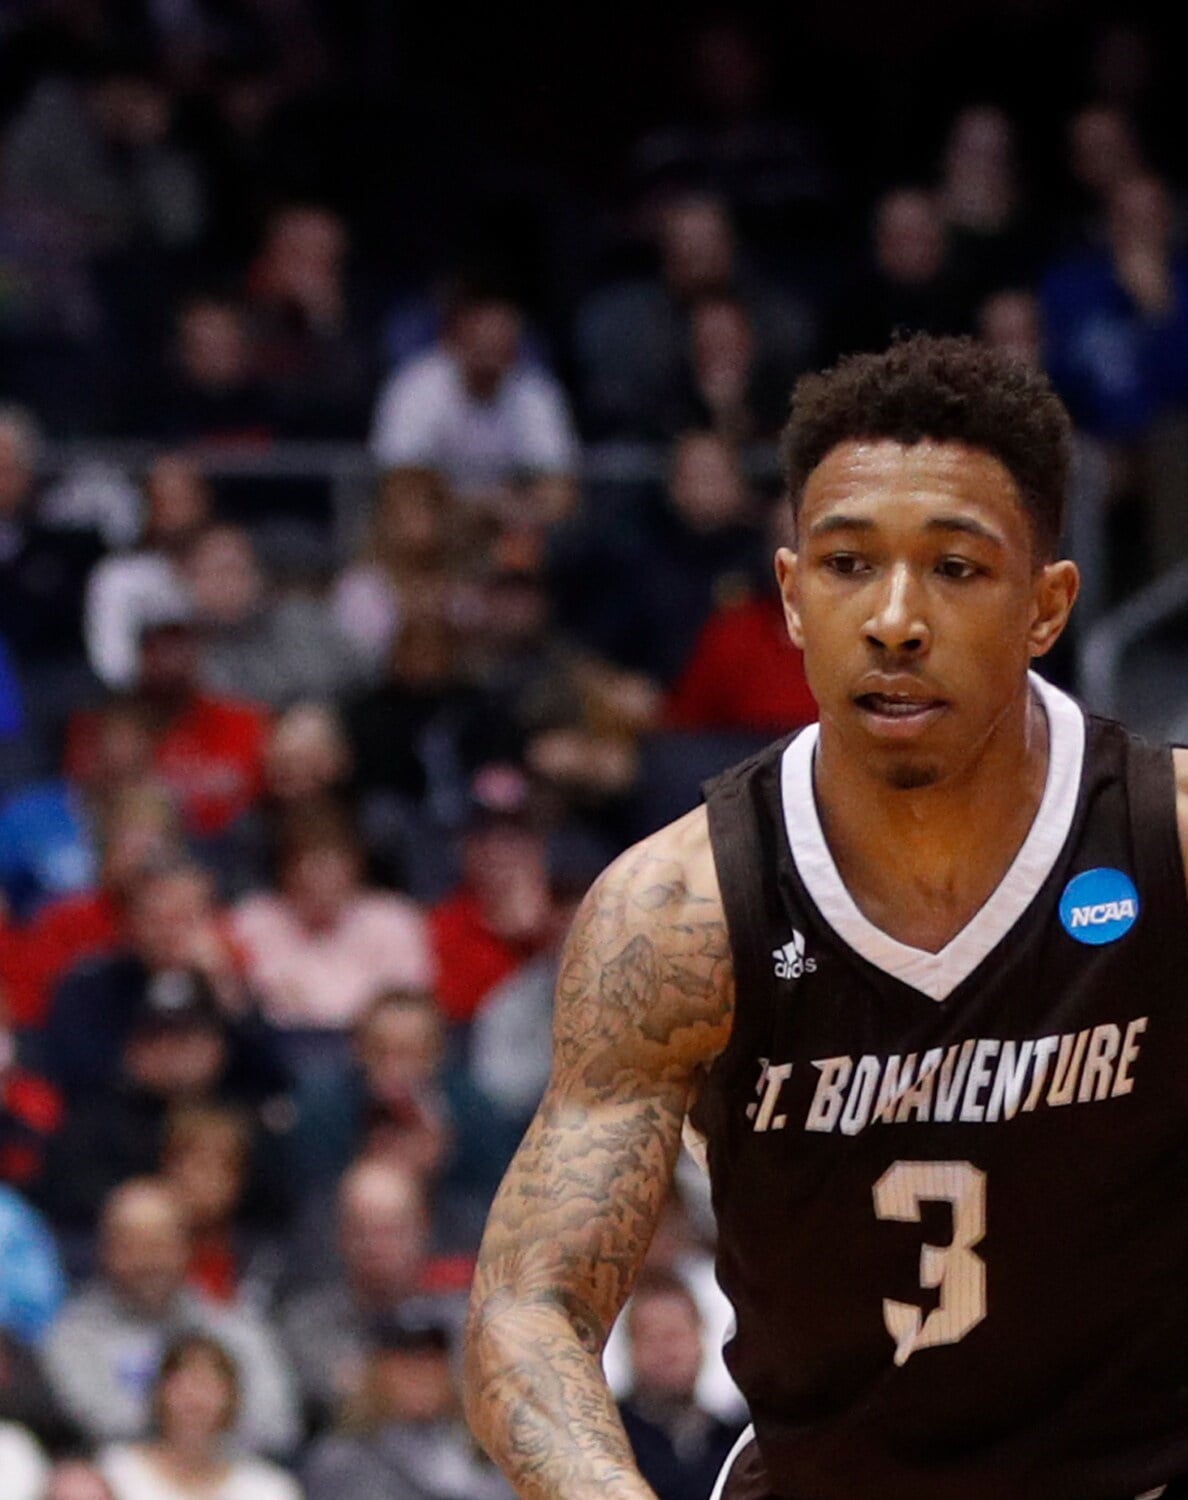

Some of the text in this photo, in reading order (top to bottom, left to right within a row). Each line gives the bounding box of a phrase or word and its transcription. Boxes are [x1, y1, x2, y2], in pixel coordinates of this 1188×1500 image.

[1070, 899, 1135, 928] NCAA
[805, 1016, 1148, 1136] BONAVENTURE
[872, 1160, 987, 1367] 3
